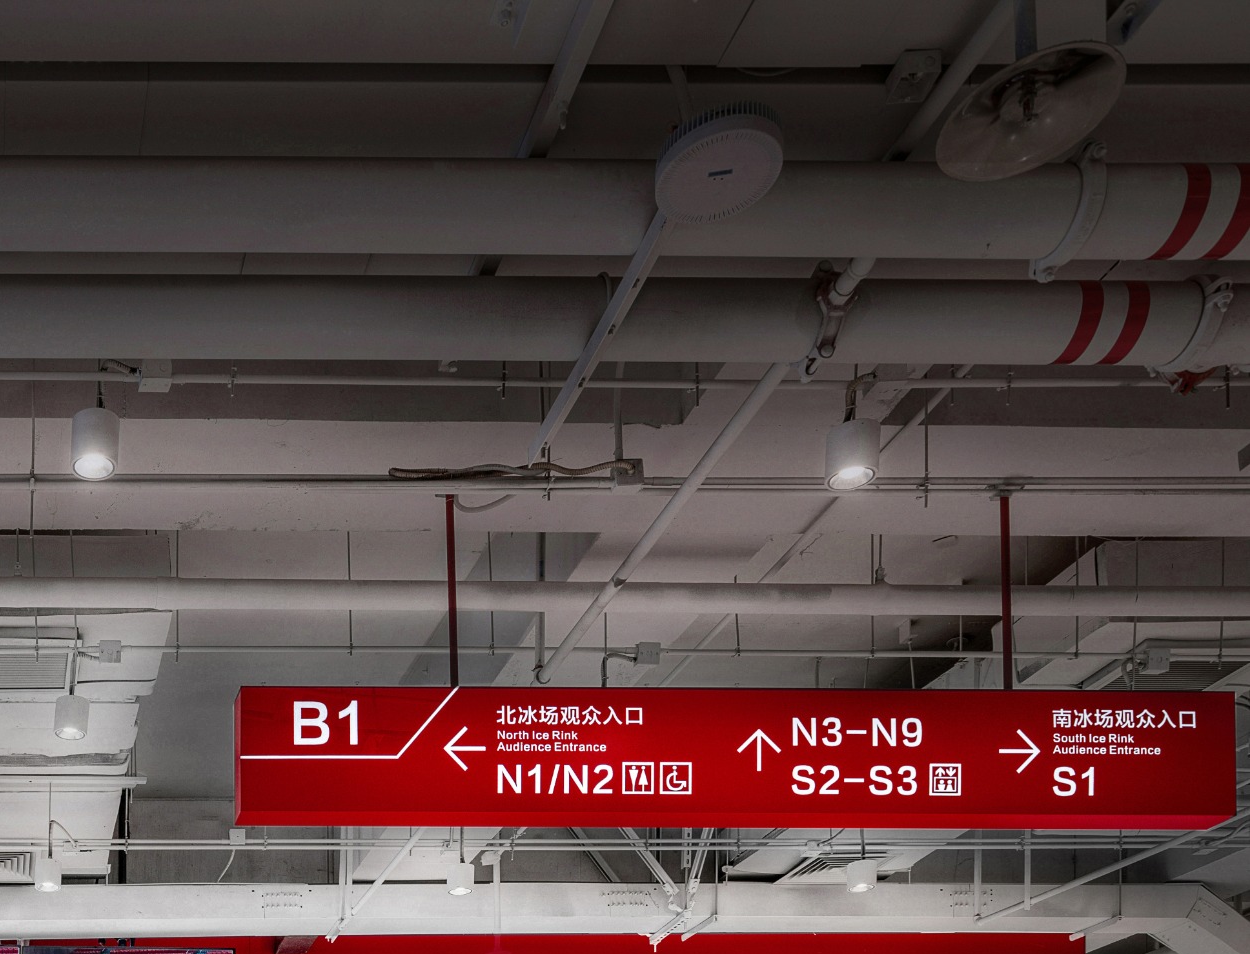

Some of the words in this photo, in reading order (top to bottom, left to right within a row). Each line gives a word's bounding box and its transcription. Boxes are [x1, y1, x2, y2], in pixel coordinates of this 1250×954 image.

[292, 699, 359, 746] B1
[496, 705, 643, 726] 北冰场观众入口
[1051, 708, 1197, 729] 南冰场观众入口
[496, 730, 530, 741] North
[532, 730, 550, 741] Ice
[551, 730, 579, 741] Rink
[791, 716, 923, 748] N3-N9
[1052, 733, 1087, 744] South
[1088, 733, 1107, 744] Ice
[1108, 733, 1135, 744] Rink
[496, 741, 552, 752] Audience
[553, 742, 607, 753] Entrance
[1052, 745, 1107, 756] Audience
[1108, 746, 1162, 756] Entrance
[496, 763, 614, 795] N1/N2
[791, 764, 918, 796] S2-S3
[1052, 766, 1095, 797] S1
